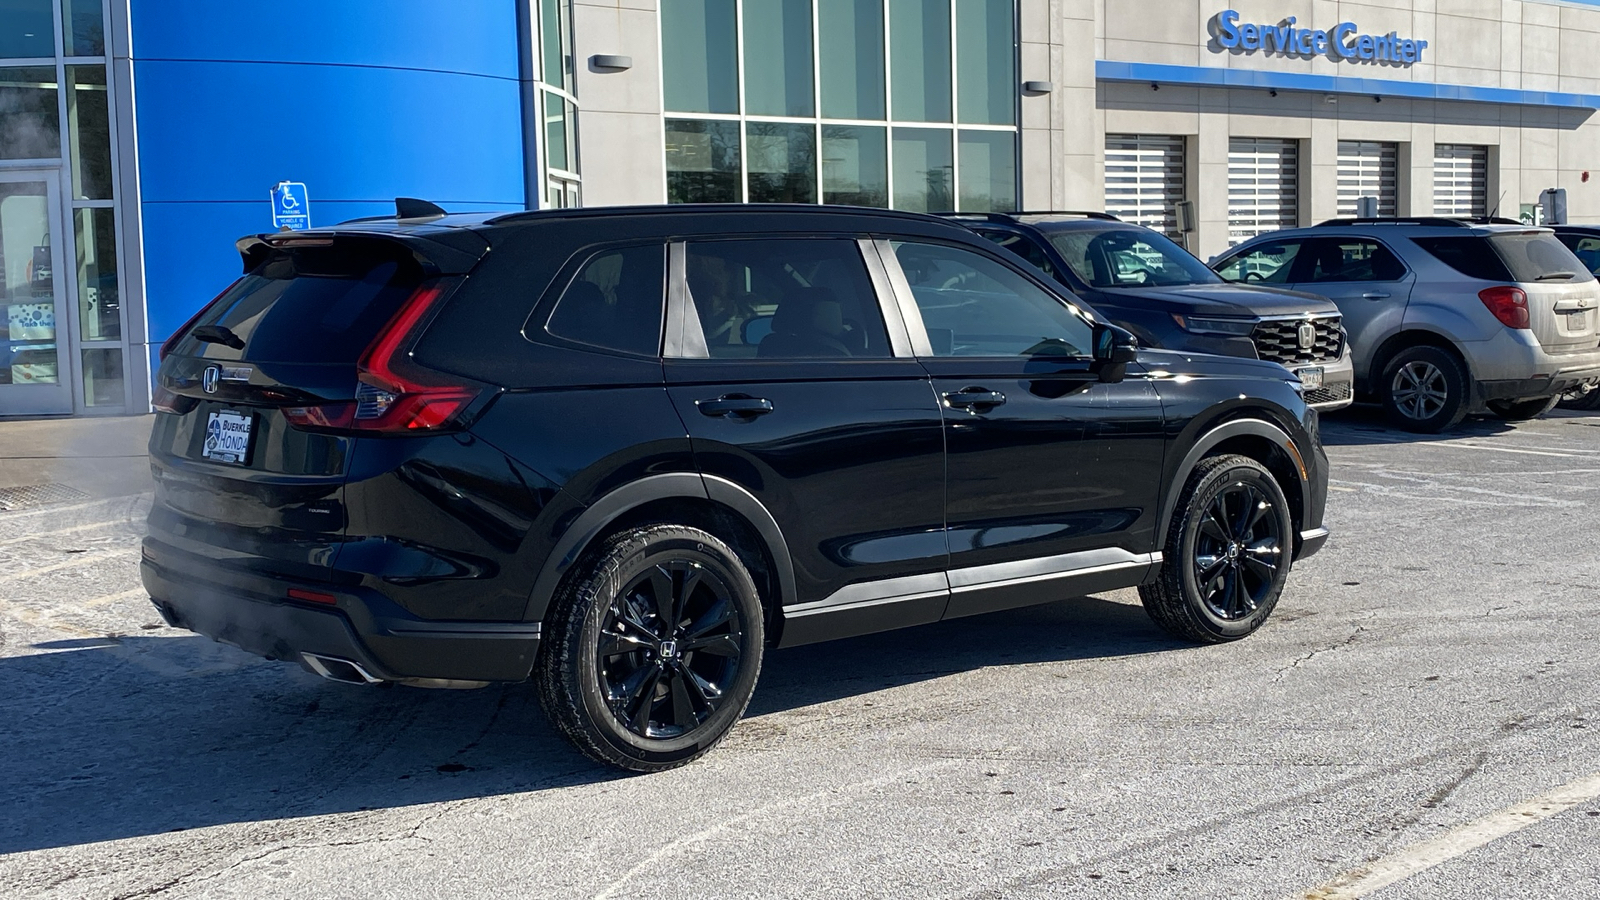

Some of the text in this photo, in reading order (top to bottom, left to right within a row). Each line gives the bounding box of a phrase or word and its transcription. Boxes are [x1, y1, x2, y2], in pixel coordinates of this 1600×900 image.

[1217, 9, 1428, 64] Service Center
[222, 420, 251, 433] BUERKLE
[219, 431, 248, 450] HONDA
